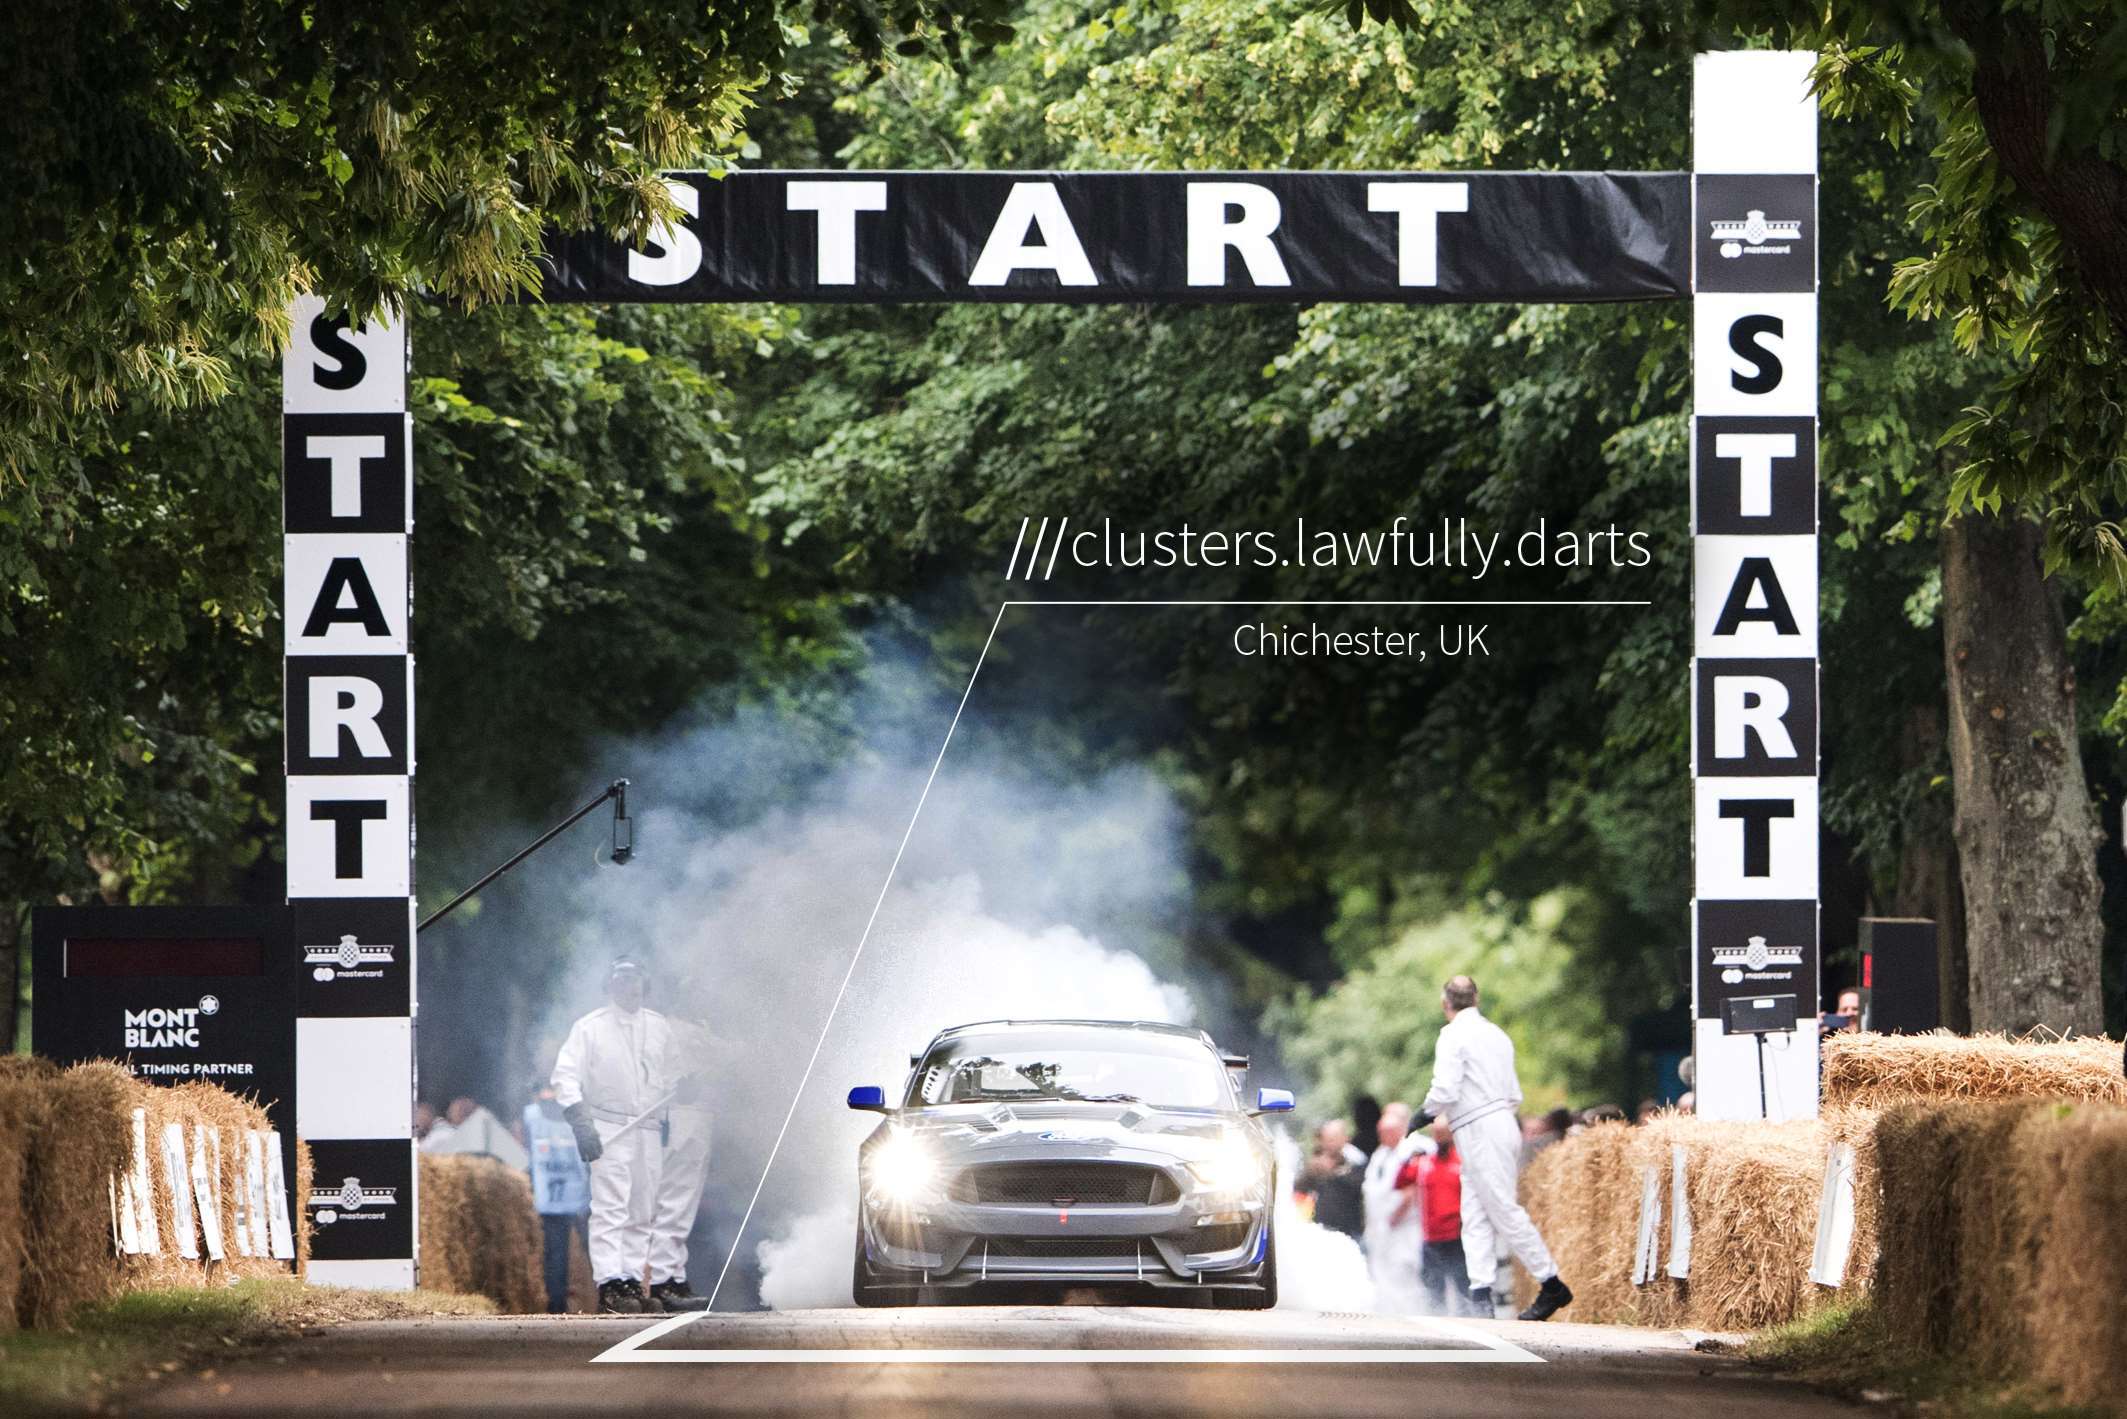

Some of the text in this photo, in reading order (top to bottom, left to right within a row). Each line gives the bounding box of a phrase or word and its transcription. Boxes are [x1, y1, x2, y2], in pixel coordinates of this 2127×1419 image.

[626, 180, 1470, 288] START
[1743, 245, 1791, 255] mastercard
[301, 308, 393, 880] START
[1712, 313, 1802, 878] START
[336, 970, 384, 978] mastercard
[1744, 971, 1793, 980] mastercard
[124, 1008, 200, 1028] MONT
[124, 1028, 200, 1048] BLANC
[141, 1063, 190, 1075] TIMING
[193, 1063, 254, 1075] PARTNER
[338, 1212, 386, 1220] mastercard
